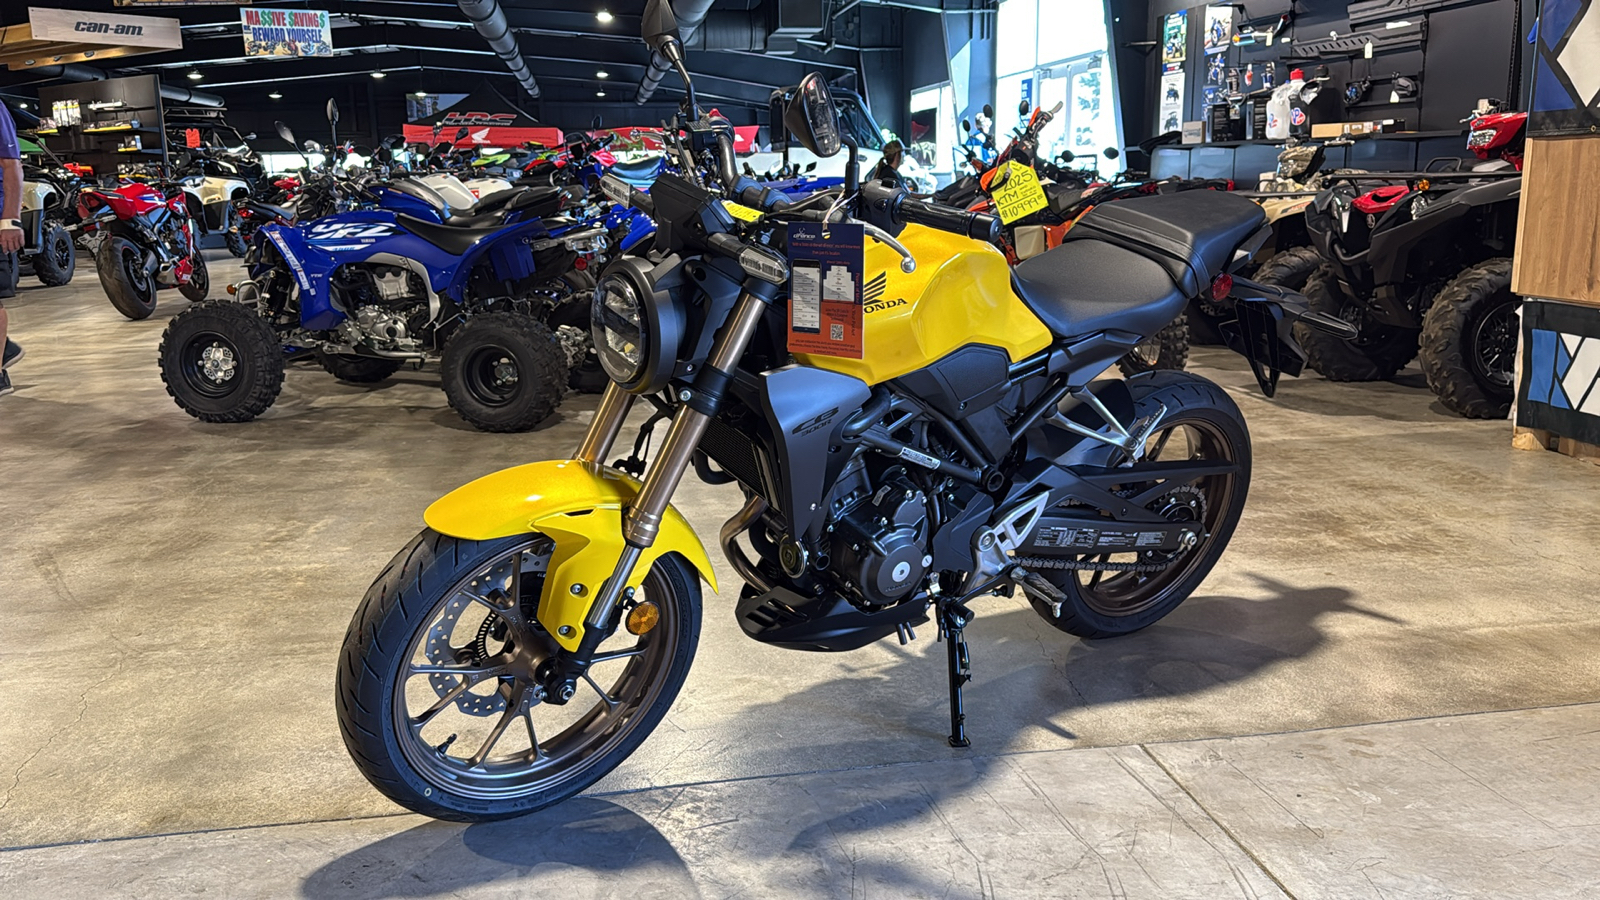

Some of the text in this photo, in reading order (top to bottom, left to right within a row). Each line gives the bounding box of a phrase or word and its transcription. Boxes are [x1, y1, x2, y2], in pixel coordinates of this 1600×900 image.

[74, 21, 143, 36] can-am
[252, 27, 286, 42] REWARD
[286, 28, 322, 43] YOURSELF
[442, 112, 517, 125] HRC
[1004, 169, 1033, 192] 2025
[996, 190, 1019, 206] KTM
[864, 298, 908, 315] ONDA
